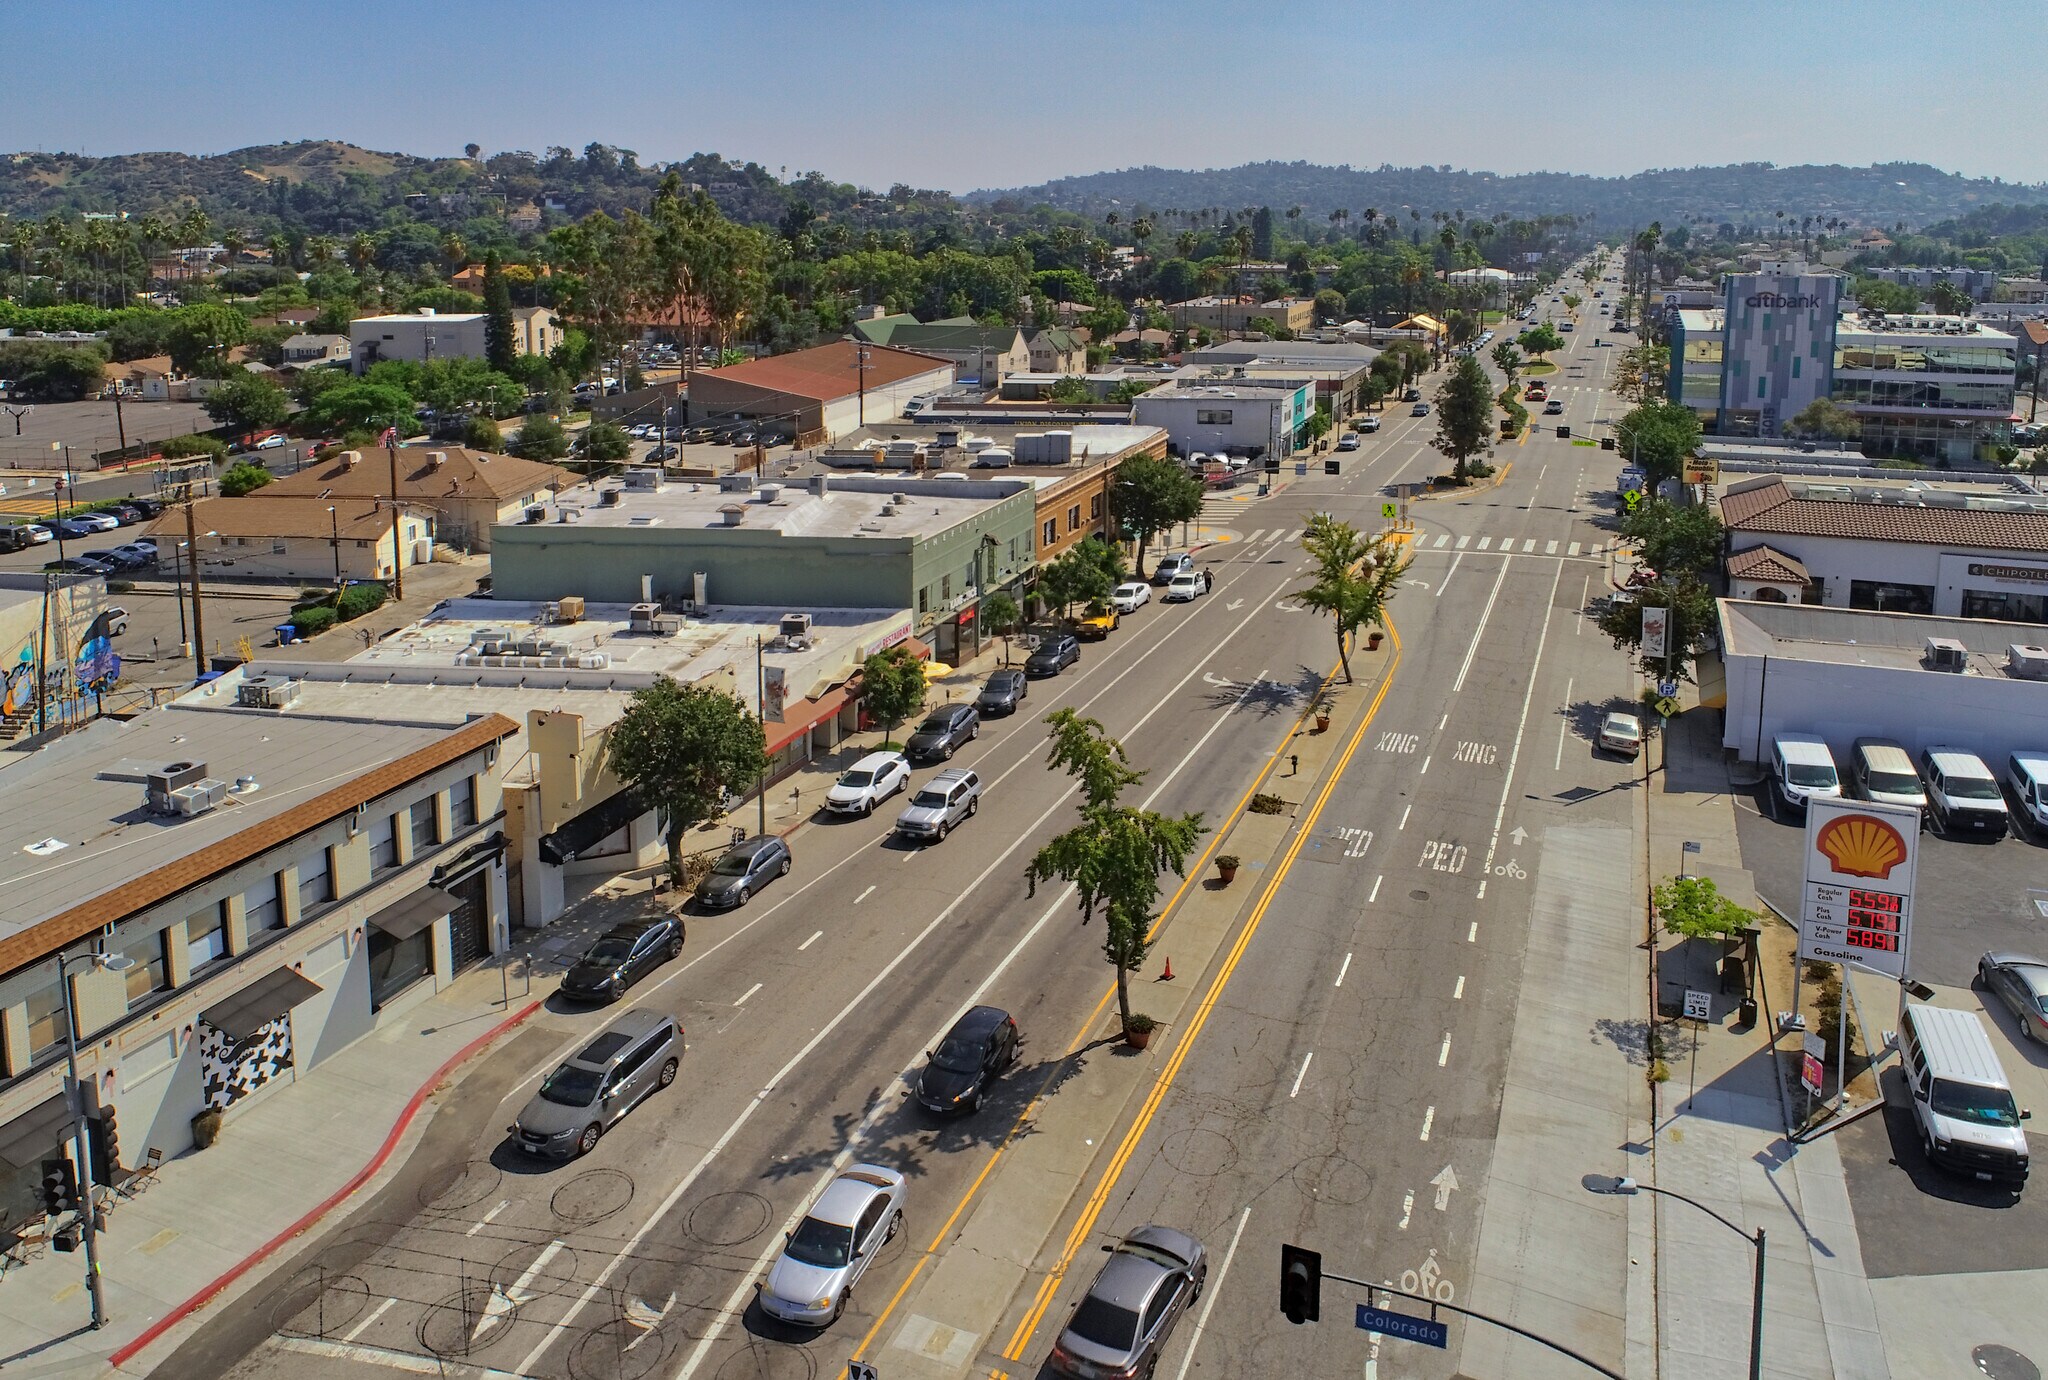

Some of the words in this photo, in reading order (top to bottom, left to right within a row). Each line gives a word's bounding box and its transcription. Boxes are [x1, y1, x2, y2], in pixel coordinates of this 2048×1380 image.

[1746, 292, 1819, 308] citibank
[882, 623, 912, 647] RESTAURANT
[1374, 731, 1419, 754] XING
[1452, 741, 1497, 765] XING
[1417, 840, 1468, 873] PED
[1817, 887, 1843, 897] Regular
[1817, 894, 1833, 902] Cash
[1816, 906, 1830, 914] Plus
[1816, 913, 1832, 921] Cash
[1814, 932, 1831, 940] Cash
[1815, 925, 1842, 935] V-Power
[1813, 947, 1863, 961] Gasoline
[1688, 1005, 1707, 1017] 35
[1363, 1312, 1439, 1340] Colorado
